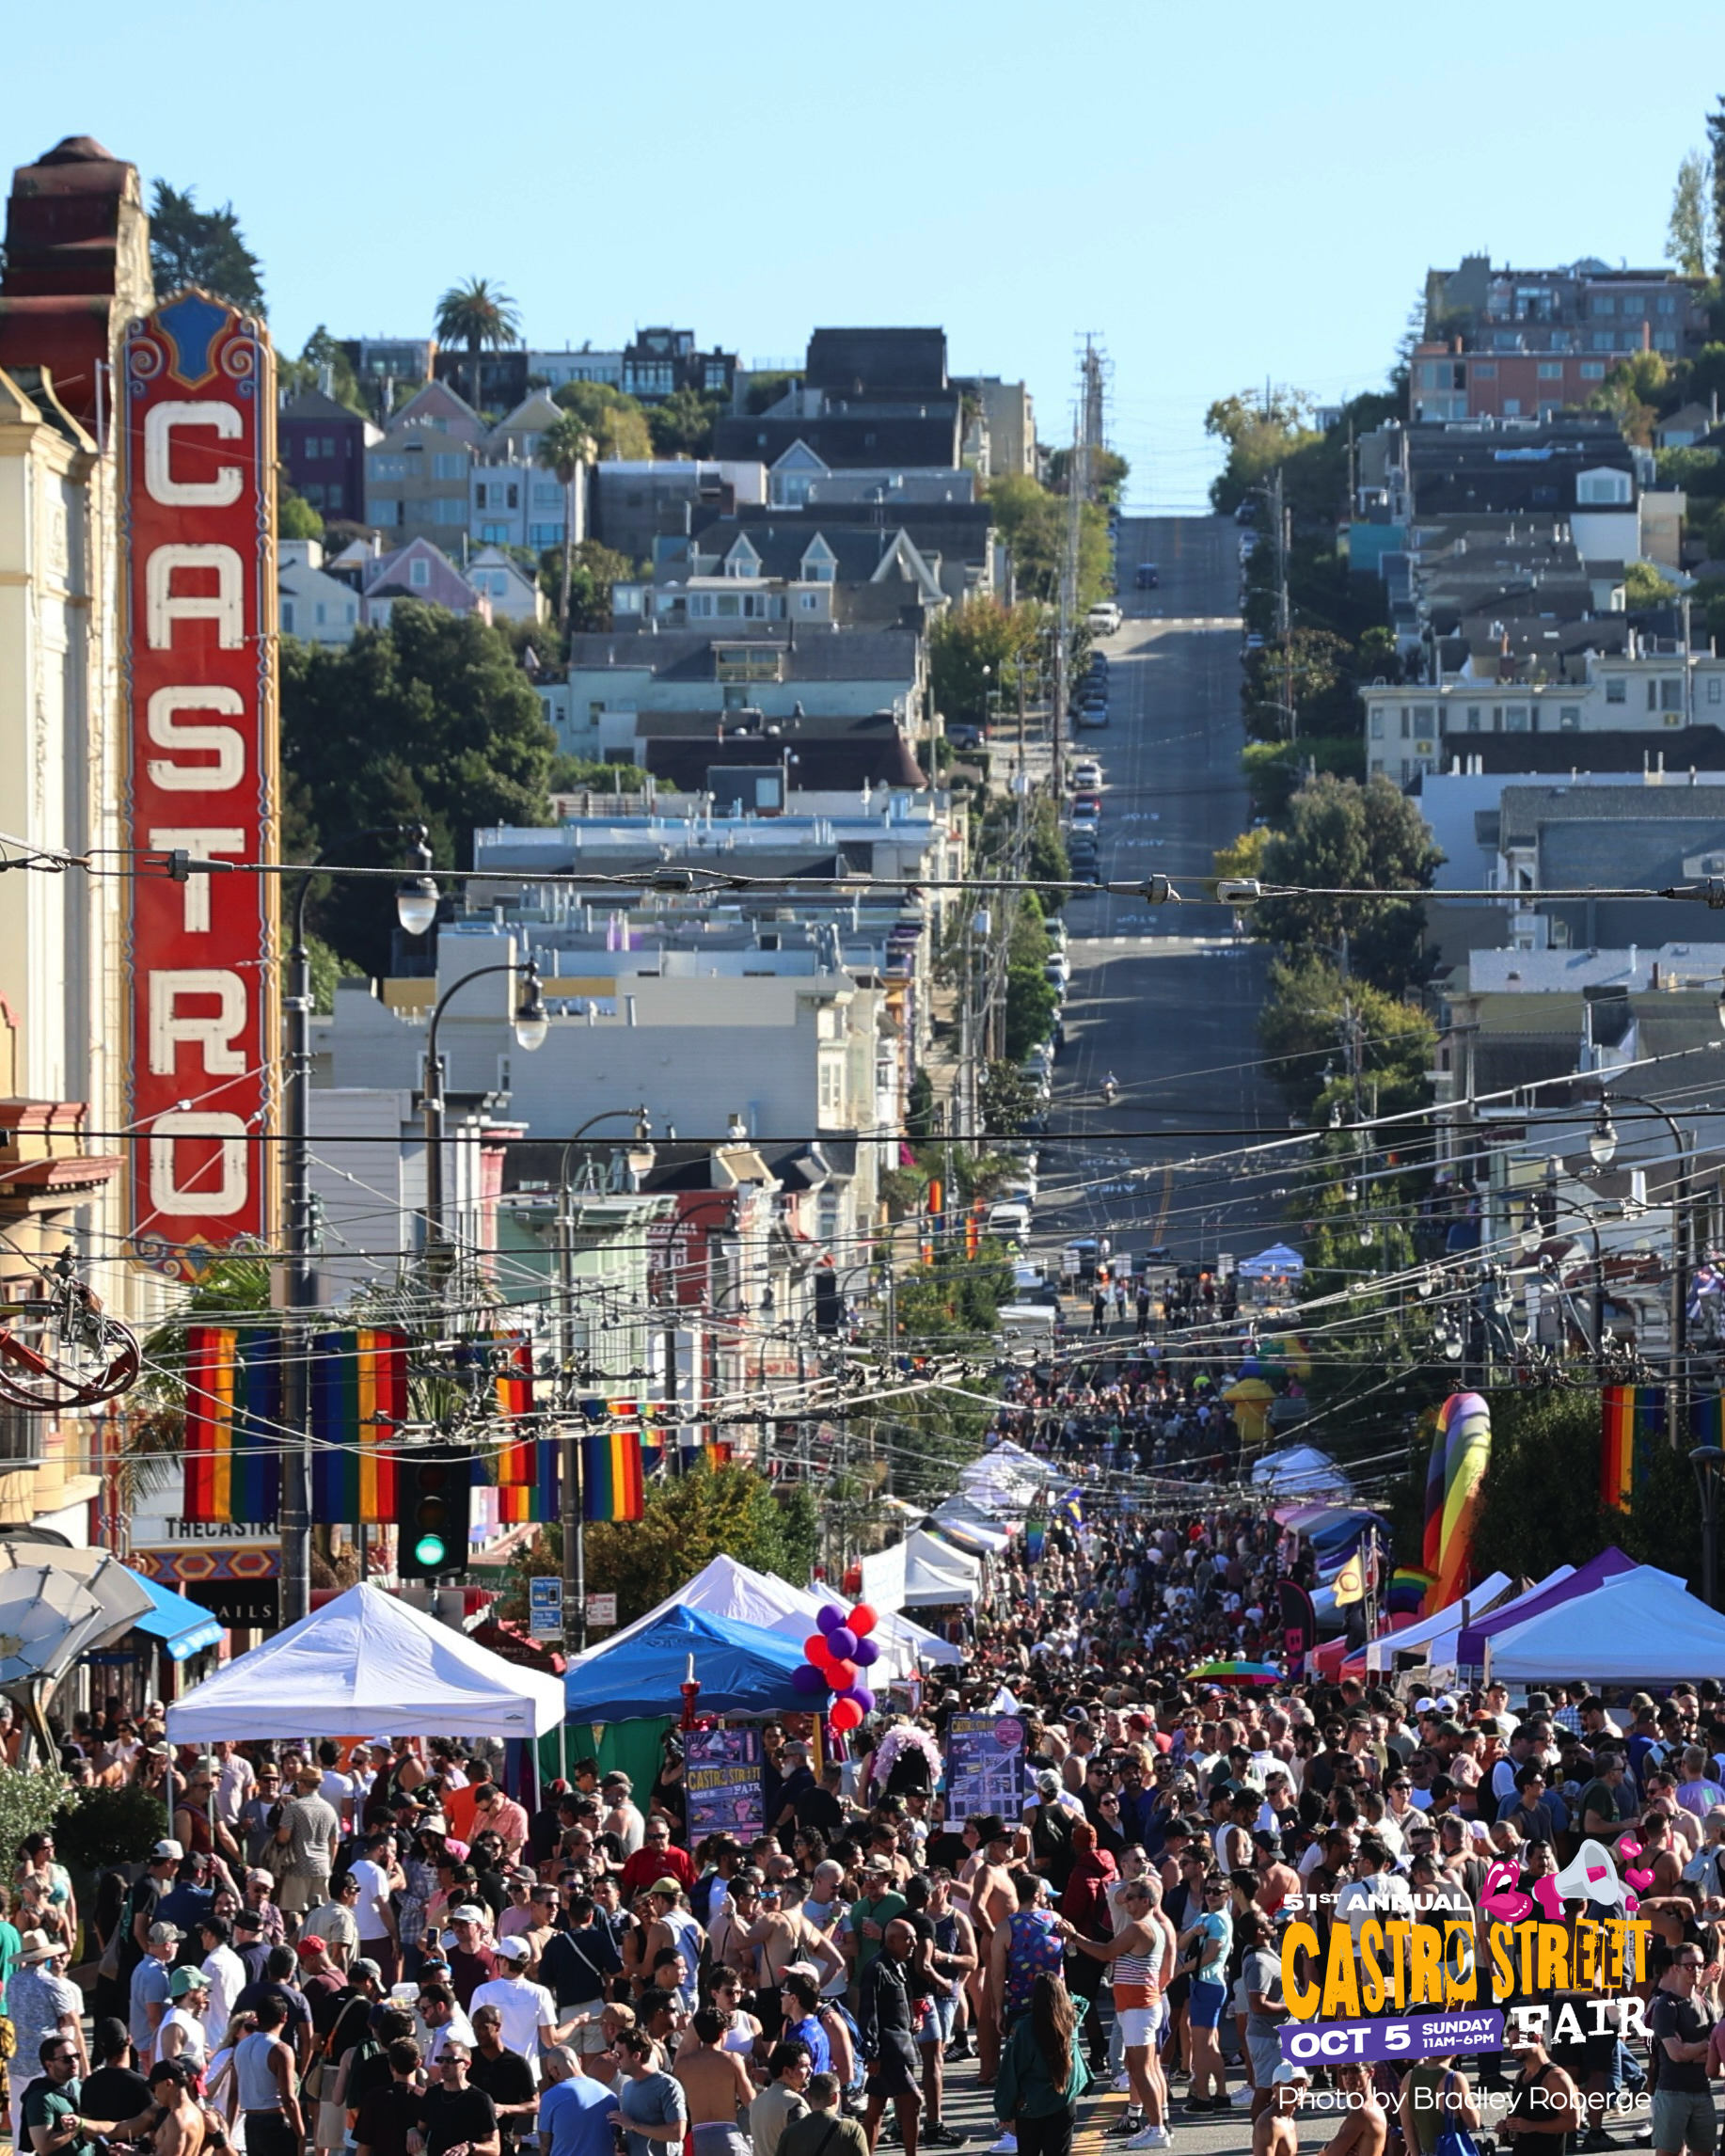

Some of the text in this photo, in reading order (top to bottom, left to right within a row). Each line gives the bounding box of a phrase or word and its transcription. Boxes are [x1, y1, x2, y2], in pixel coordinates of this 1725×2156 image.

[145, 401, 247, 1216] CASTRO
[209, 1605, 273, 1618] AILS
[734, 1783, 762, 1795] FAIR
